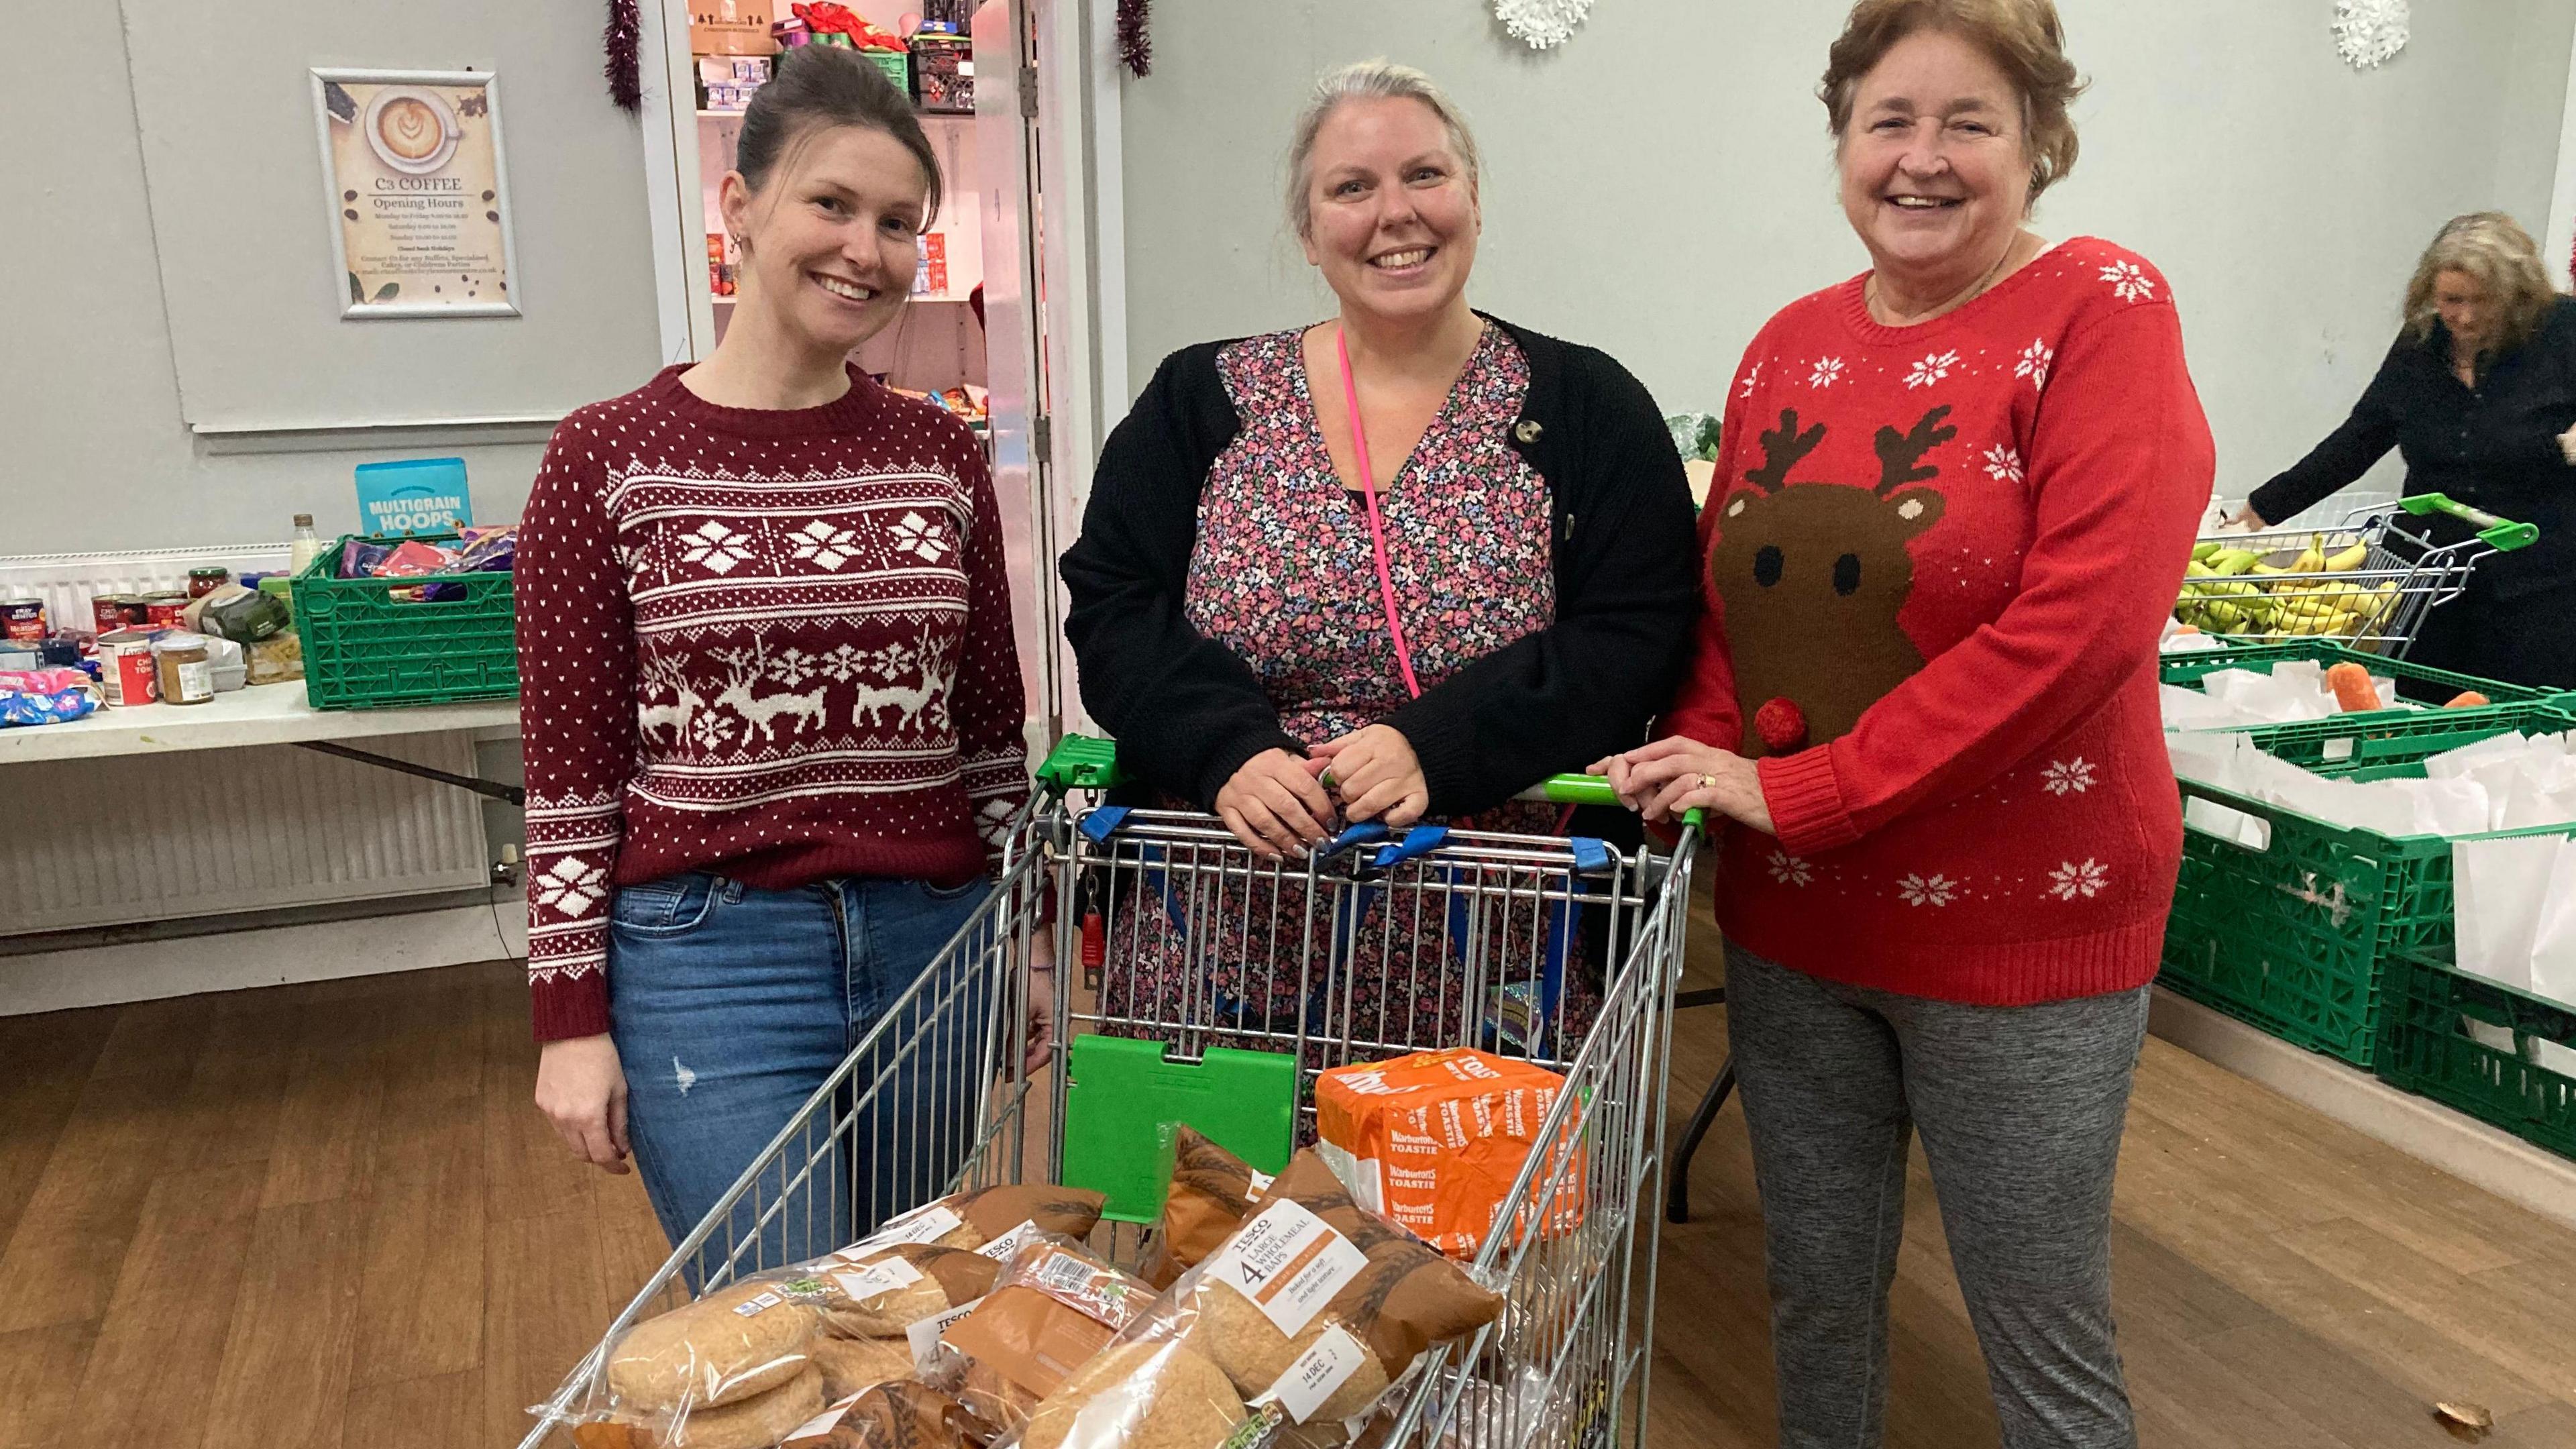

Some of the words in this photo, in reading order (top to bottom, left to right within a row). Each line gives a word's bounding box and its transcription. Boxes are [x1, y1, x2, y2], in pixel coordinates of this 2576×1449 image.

[376, 178, 395, 190] C3
[399, 178, 462, 191] COFFEE
[374, 198, 425, 210] Opening
[428, 198, 464, 208] Hours
[370, 496, 461, 515] MULTIGRAIN
[380, 511, 454, 531] HOOPS
[1503, 1089, 1515, 1136] TOASTIE
[1439, 1101, 1457, 1149] TOASTIE
[1391, 1144, 1438, 1155] TOASTIE
[1389, 1163, 1436, 1179] Warburtons
[1389, 1178, 1436, 1189] TOASTIE
[906, 1230, 914, 1240] 14
[1232, 1218, 1269, 1251] TESCO
[1256, 1218, 1310, 1266] WHOLEMEAL
[1248, 1234, 1279, 1260] LARGE
[1241, 1260, 1267, 1284] 4
[1265, 1251, 1287, 1273] BAPS
[1288, 1277, 1305, 1294] Baked
[1303, 1271, 1312, 1283] for
[1316, 1258, 1326, 1271] soft
[1297, 1291, 1308, 1303] and
[1307, 1282, 1320, 1294] light
[1318, 1266, 1336, 1285] texture
[1302, 1372, 1312, 1383] 14
[1309, 1358, 1325, 1377] DEC
